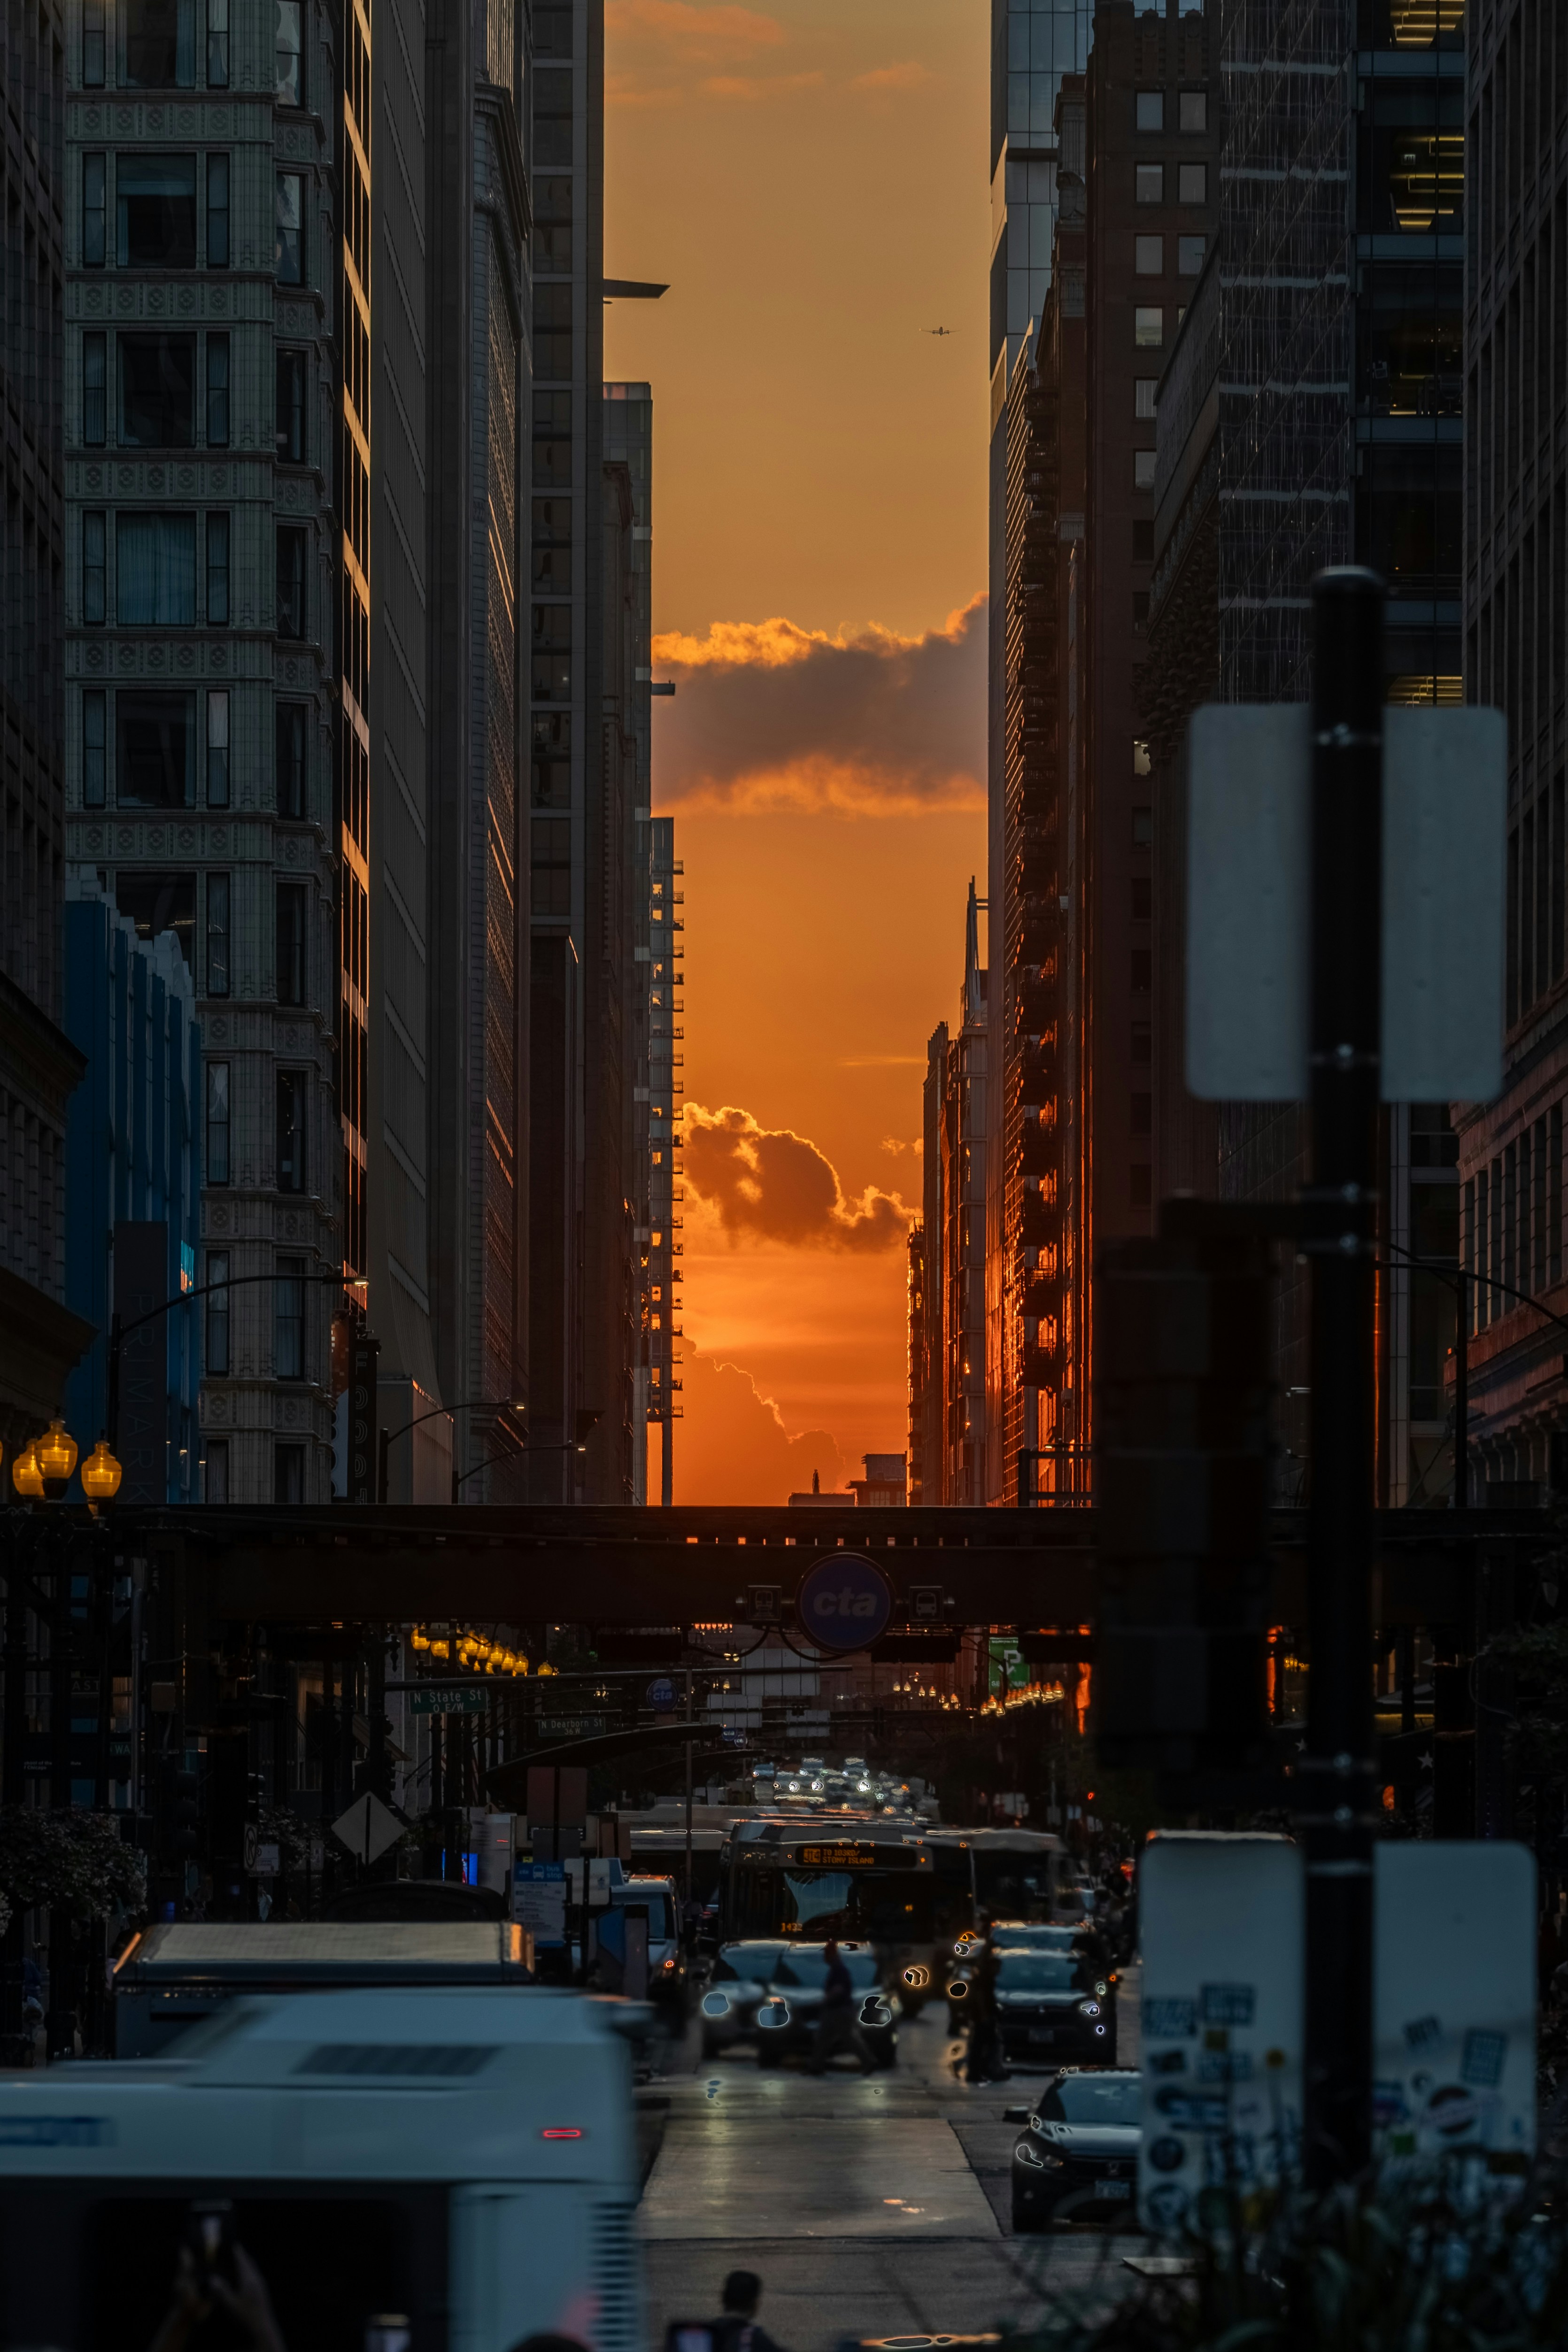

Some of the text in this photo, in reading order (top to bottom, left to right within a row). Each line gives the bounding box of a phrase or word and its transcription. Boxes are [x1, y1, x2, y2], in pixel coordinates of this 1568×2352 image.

[127, 1294, 154, 1504] PRIMARK
[813, 1587, 877, 1617] cta
[414, 1689, 481, 1704] N State St
[653, 1691, 672, 1701] cta
[445, 1702, 464, 1712] E/W
[551, 1720, 589, 1728] Dearborn
[594, 1718, 602, 1727] St
